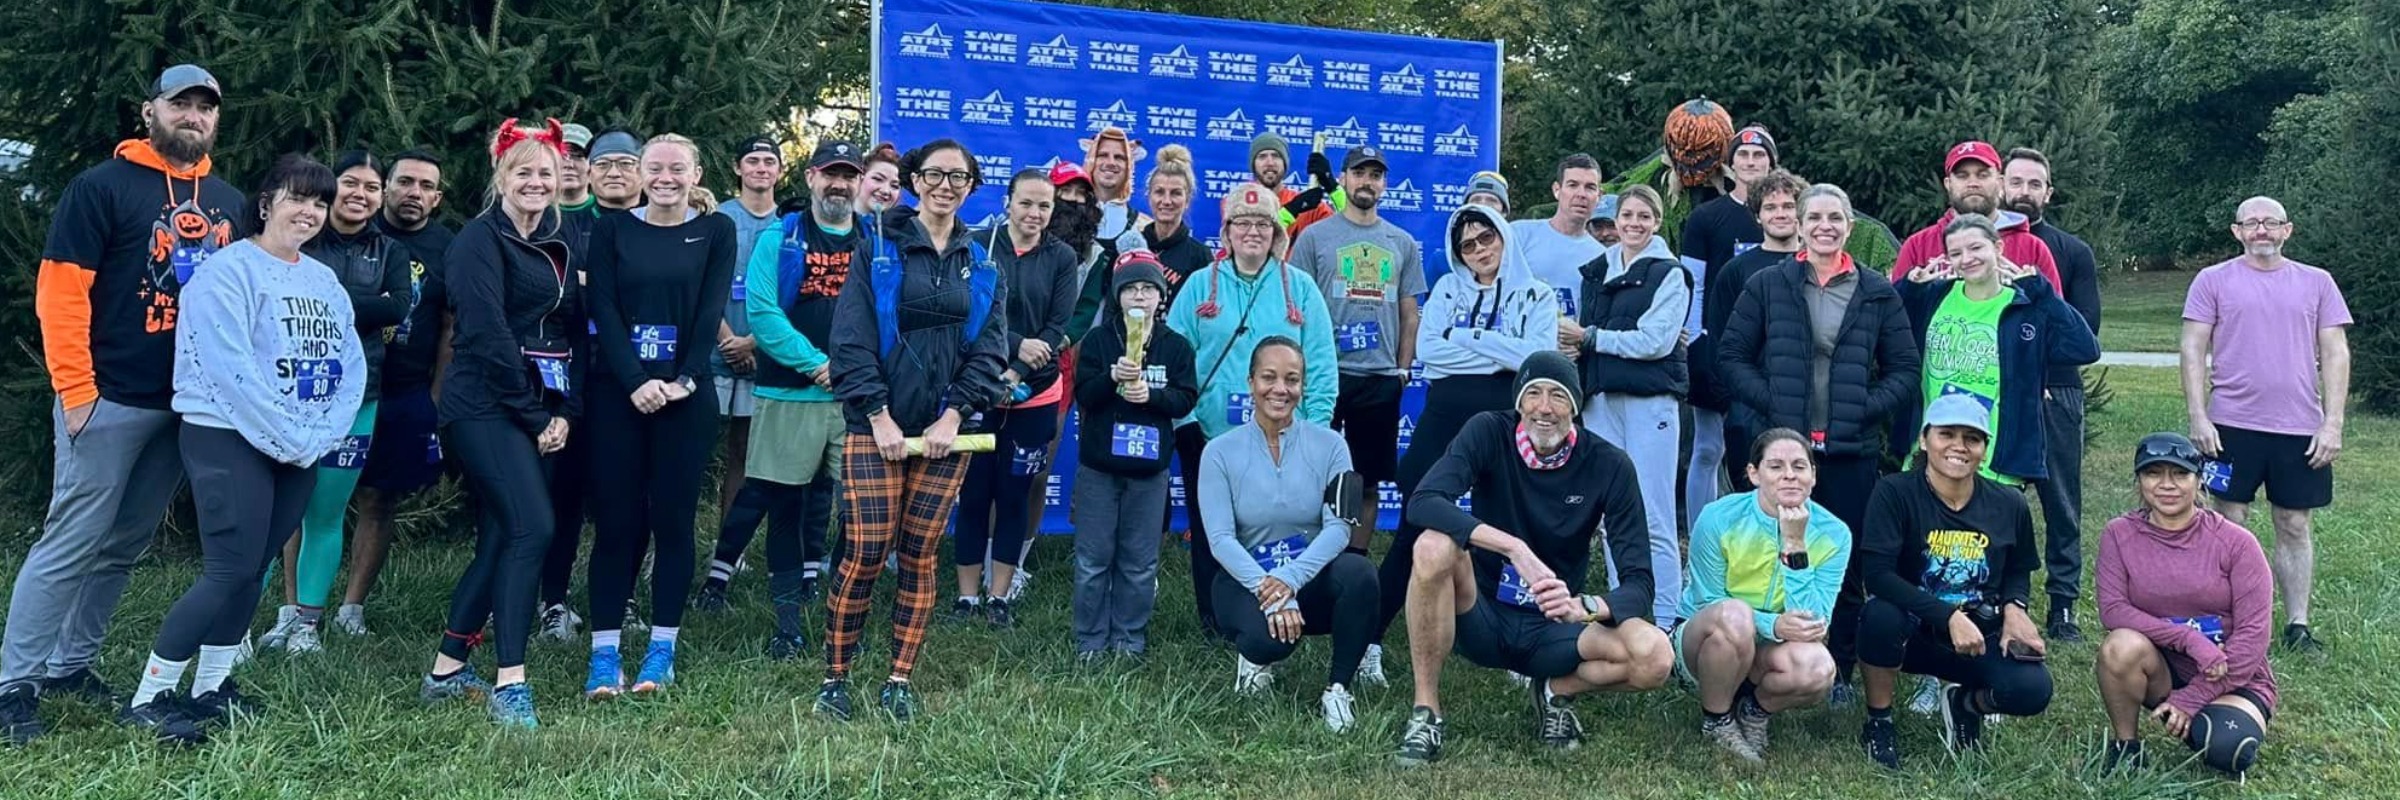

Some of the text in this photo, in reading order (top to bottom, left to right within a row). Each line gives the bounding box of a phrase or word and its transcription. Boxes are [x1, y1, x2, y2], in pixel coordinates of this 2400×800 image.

[963, 30, 1017, 42] SAVE
[963, 41, 1017, 54] THE
[1088, 41, 1139, 53] SAVE
[1088, 51, 1139, 65] THE
[1208, 51, 1256, 63] SAVE
[1208, 61, 1256, 75] THE
[1322, 60, 1370, 71] SAVE
[1322, 70, 1370, 83] THE
[1433, 69, 1479, 80] SAVE
[1433, 79, 1479, 91] THE
[896, 87, 950, 99] SAVE
[896, 98, 950, 111] THE
[1024, 97, 1076, 108] SAVE
[1024, 107, 1076, 120] THE
[1147, 106, 1197, 117] SAVE
[1147, 116, 1197, 129] THE
[1264, 115, 1313, 126] SAVE
[1264, 124, 1313, 137] THE
[1378, 122, 1424, 133] SAVE
[1378, 132, 1424, 144] THE
[973, 155, 1012, 165] AVE
[980, 166, 1011, 177] HE
[1432, 183, 1467, 193] SAV
[1432, 194, 1464, 205] TH
[154, 291, 174, 307] MY
[281, 296, 335, 319] THICK
[281, 317, 342, 340] THIGHS
[302, 340, 329, 358] AND
[1352, 336, 1366, 349] 93
[640, 343, 658, 359] 90
[312, 379, 329, 396] 80
[1128, 440, 1145, 456] 65
[337, 452, 357, 467] 67
[1025, 461, 1040, 475] 72
[1927, 529, 1989, 548] HAUNTED
[1928, 545, 1984, 559] TRAIL RUN
